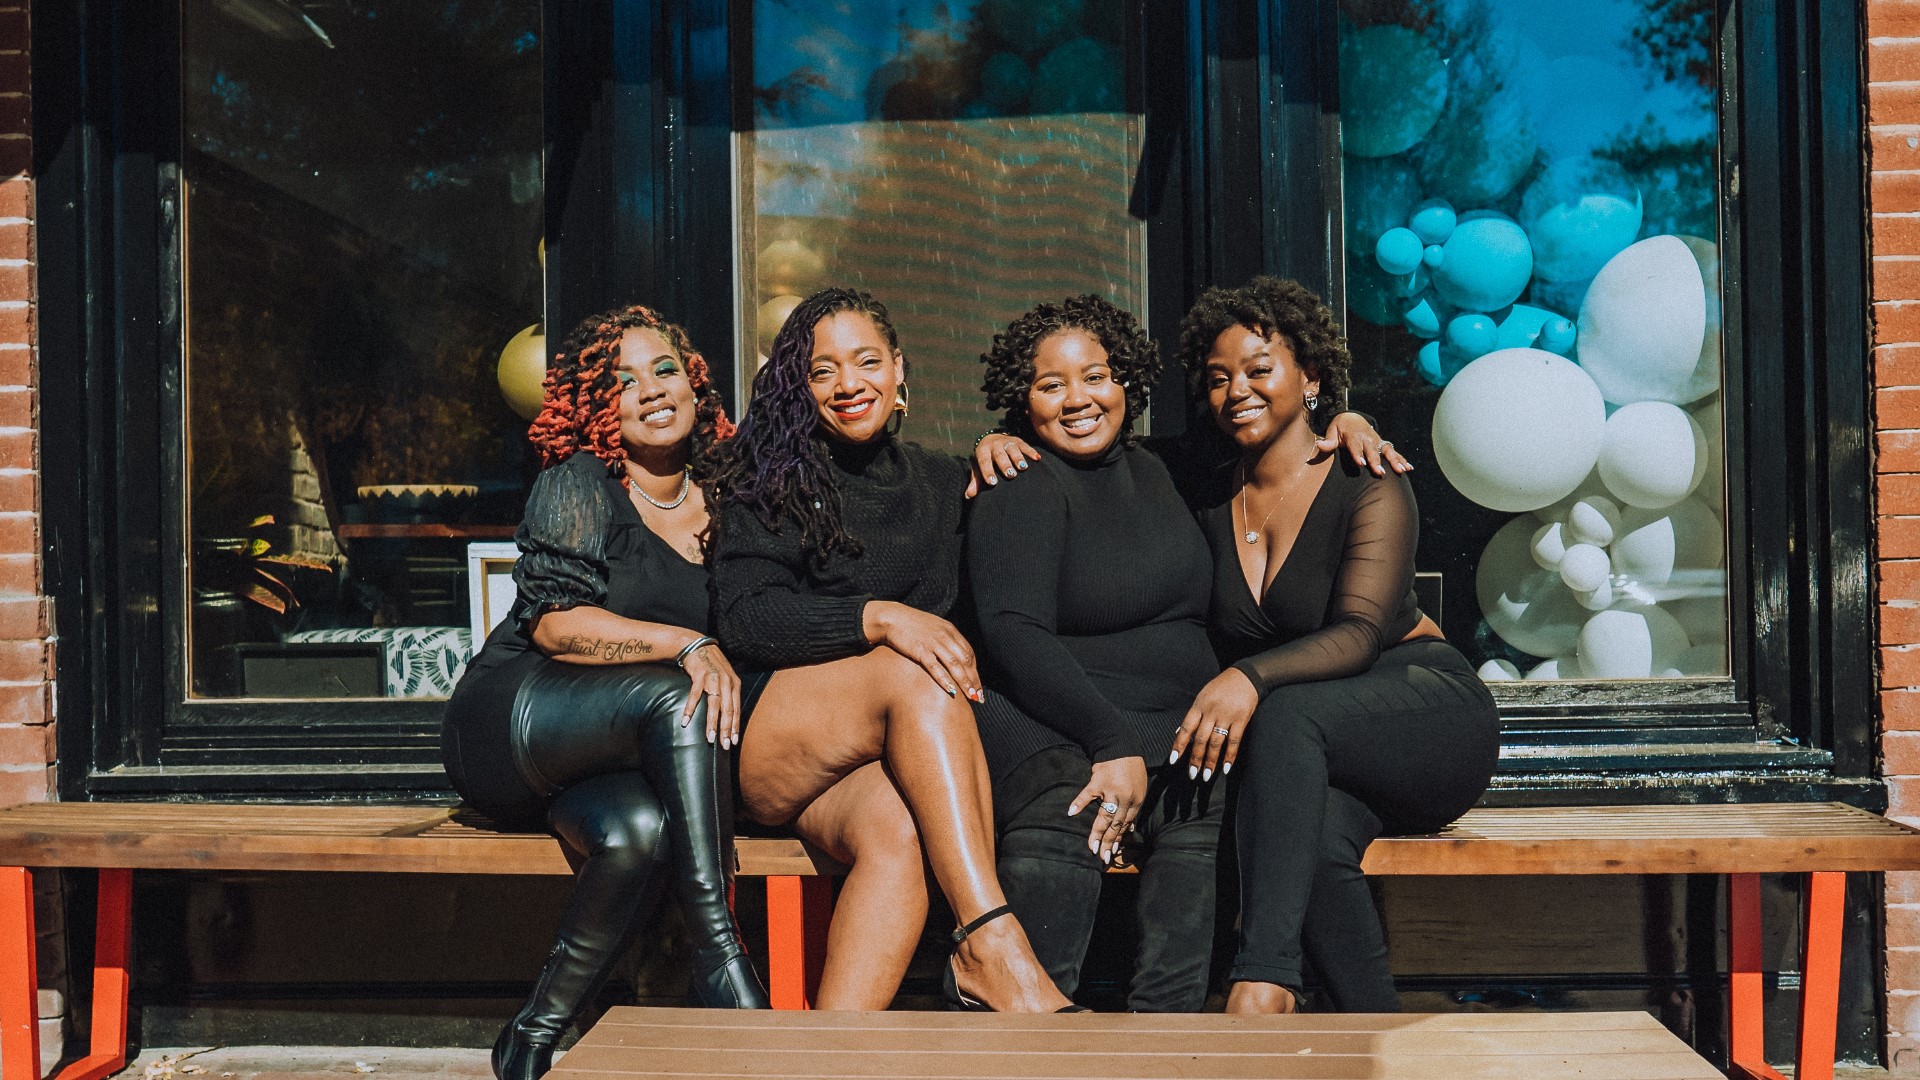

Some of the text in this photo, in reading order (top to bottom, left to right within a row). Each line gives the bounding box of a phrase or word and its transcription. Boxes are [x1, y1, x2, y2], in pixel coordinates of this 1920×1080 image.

[559, 635, 653, 660] Trust No One
